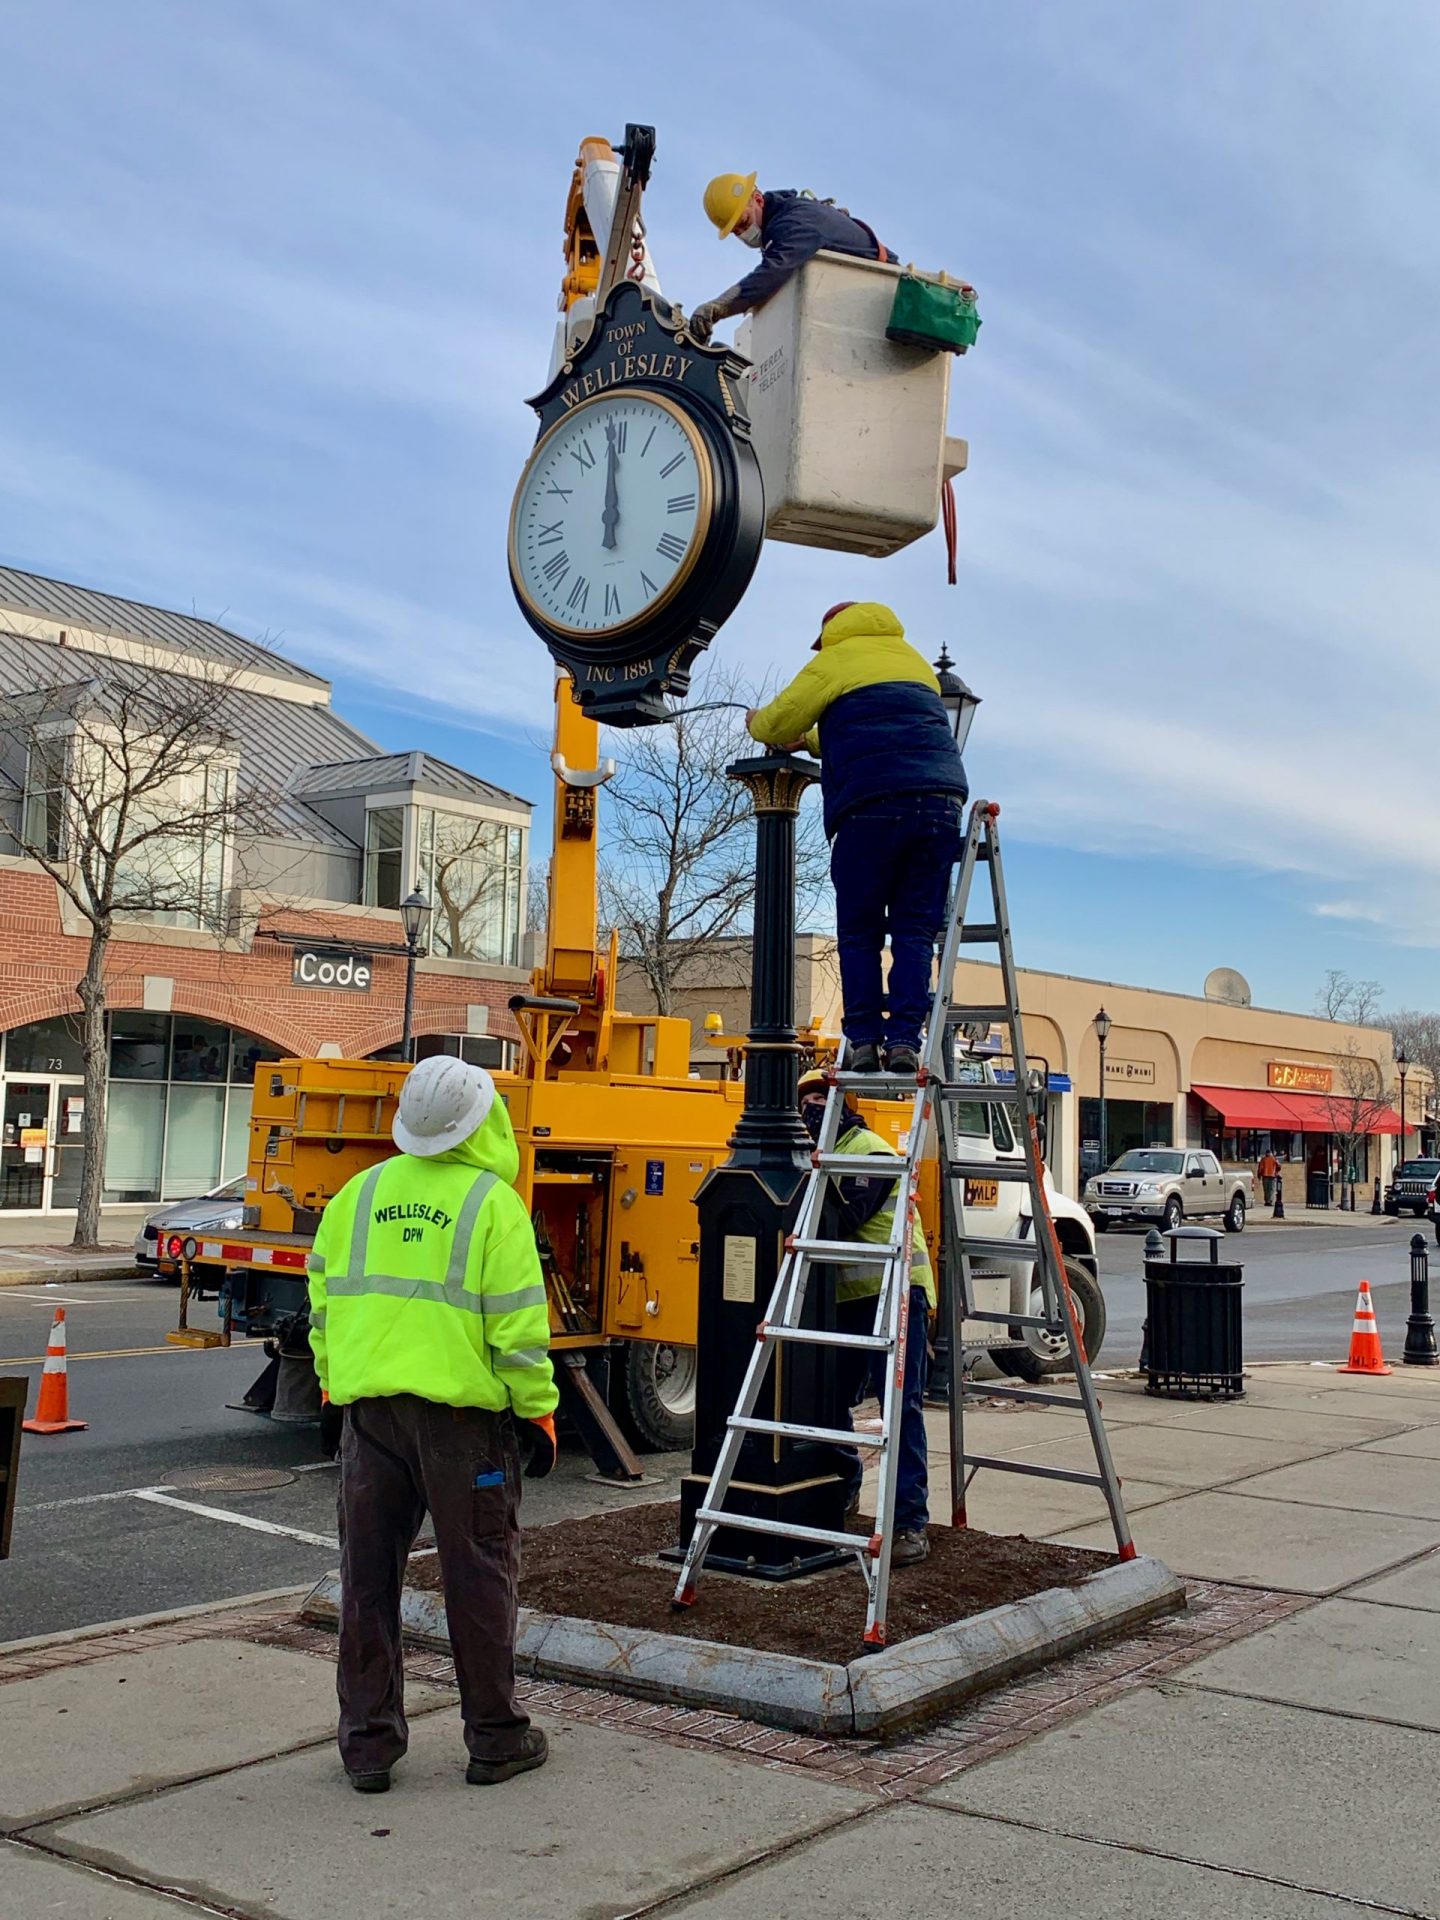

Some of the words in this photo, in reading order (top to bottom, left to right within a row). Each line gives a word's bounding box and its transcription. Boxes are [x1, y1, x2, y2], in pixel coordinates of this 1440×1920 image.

[607, 321, 646, 343] TOWN
[618, 340, 634, 356] OF
[560, 353, 694, 409] WELLESLEY
[570, 439, 596, 477] XI
[546, 479, 573, 504] X
[667, 493, 696, 514] III
[542, 549, 571, 592] VIII
[566, 575, 591, 613] VII
[640, 569, 659, 600] V
[586, 665, 616, 683] INC
[623, 659, 654, 680] 1881
[48, 1059, 63, 1070] 73
[374, 1203, 452, 1230] WELLESLEY
[403, 1227, 424, 1243] DPW
